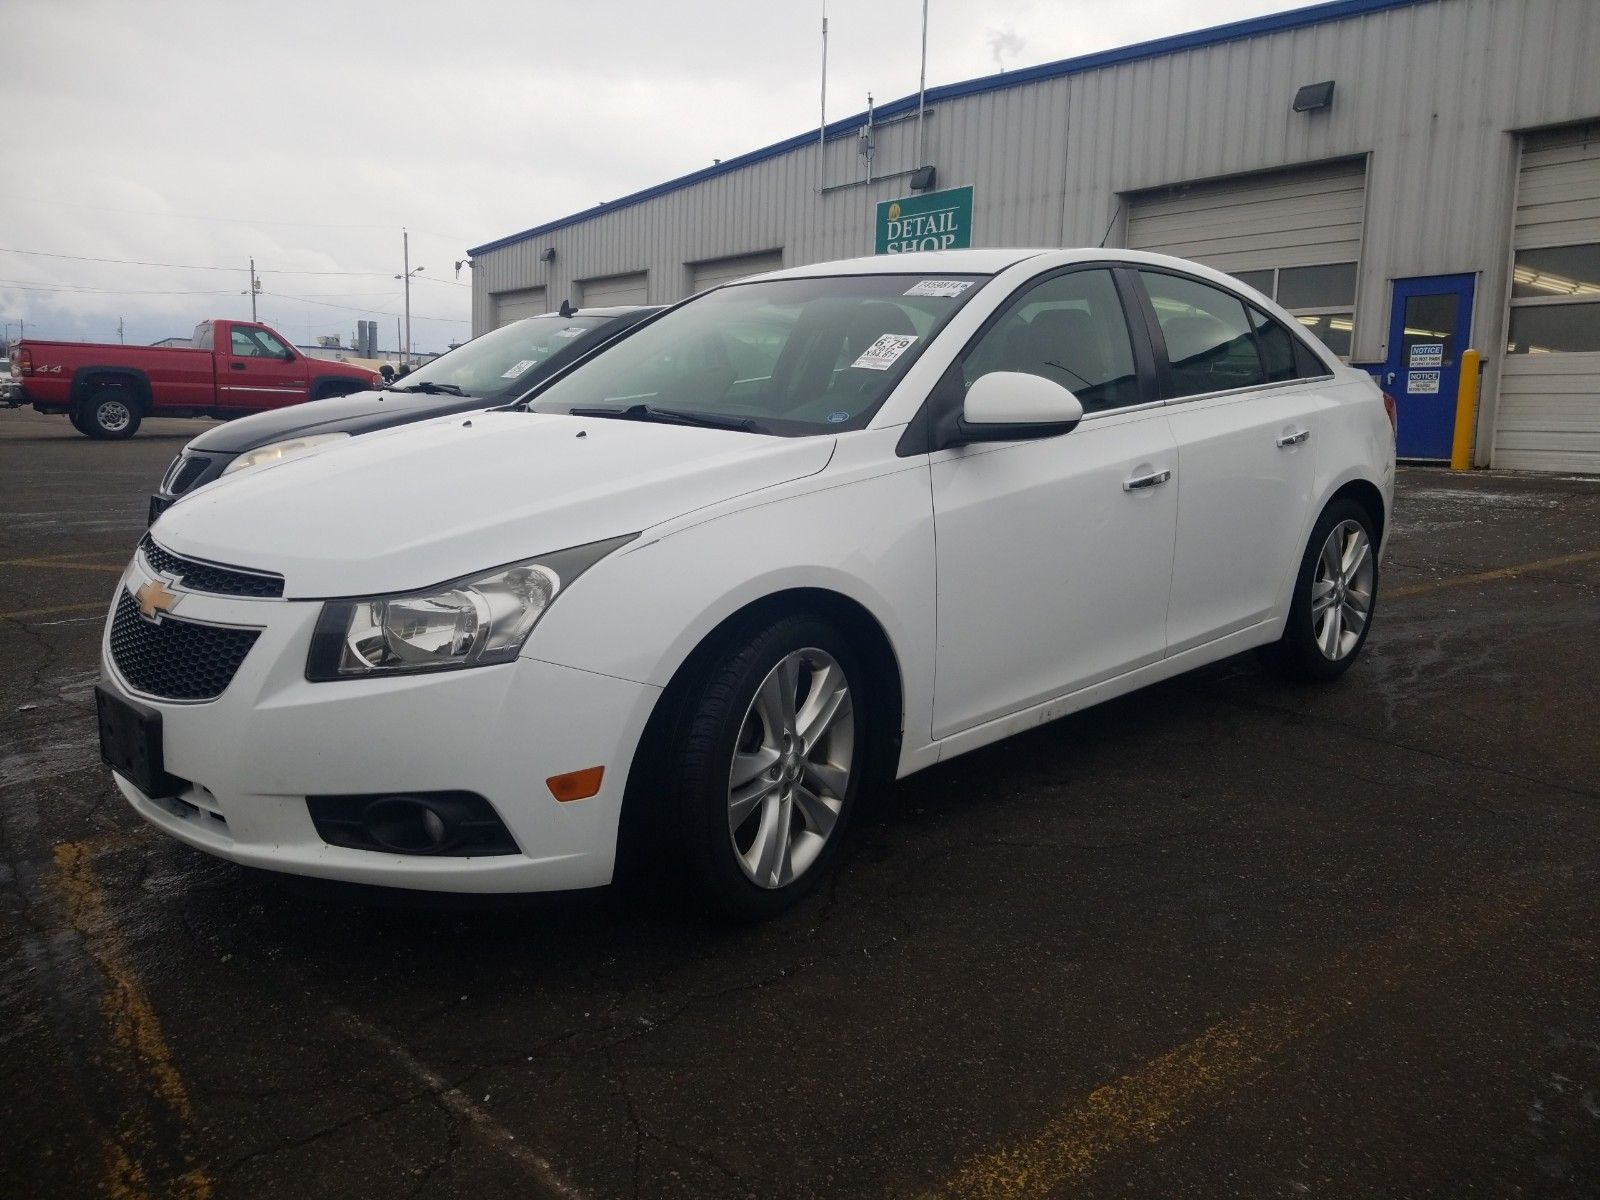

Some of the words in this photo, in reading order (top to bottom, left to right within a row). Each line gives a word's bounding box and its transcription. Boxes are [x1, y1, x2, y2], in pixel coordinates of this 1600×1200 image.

[887, 212, 958, 240] DETAIL
[886, 234, 955, 254] SHOP
[1412, 347, 1440, 355] NOTICE
